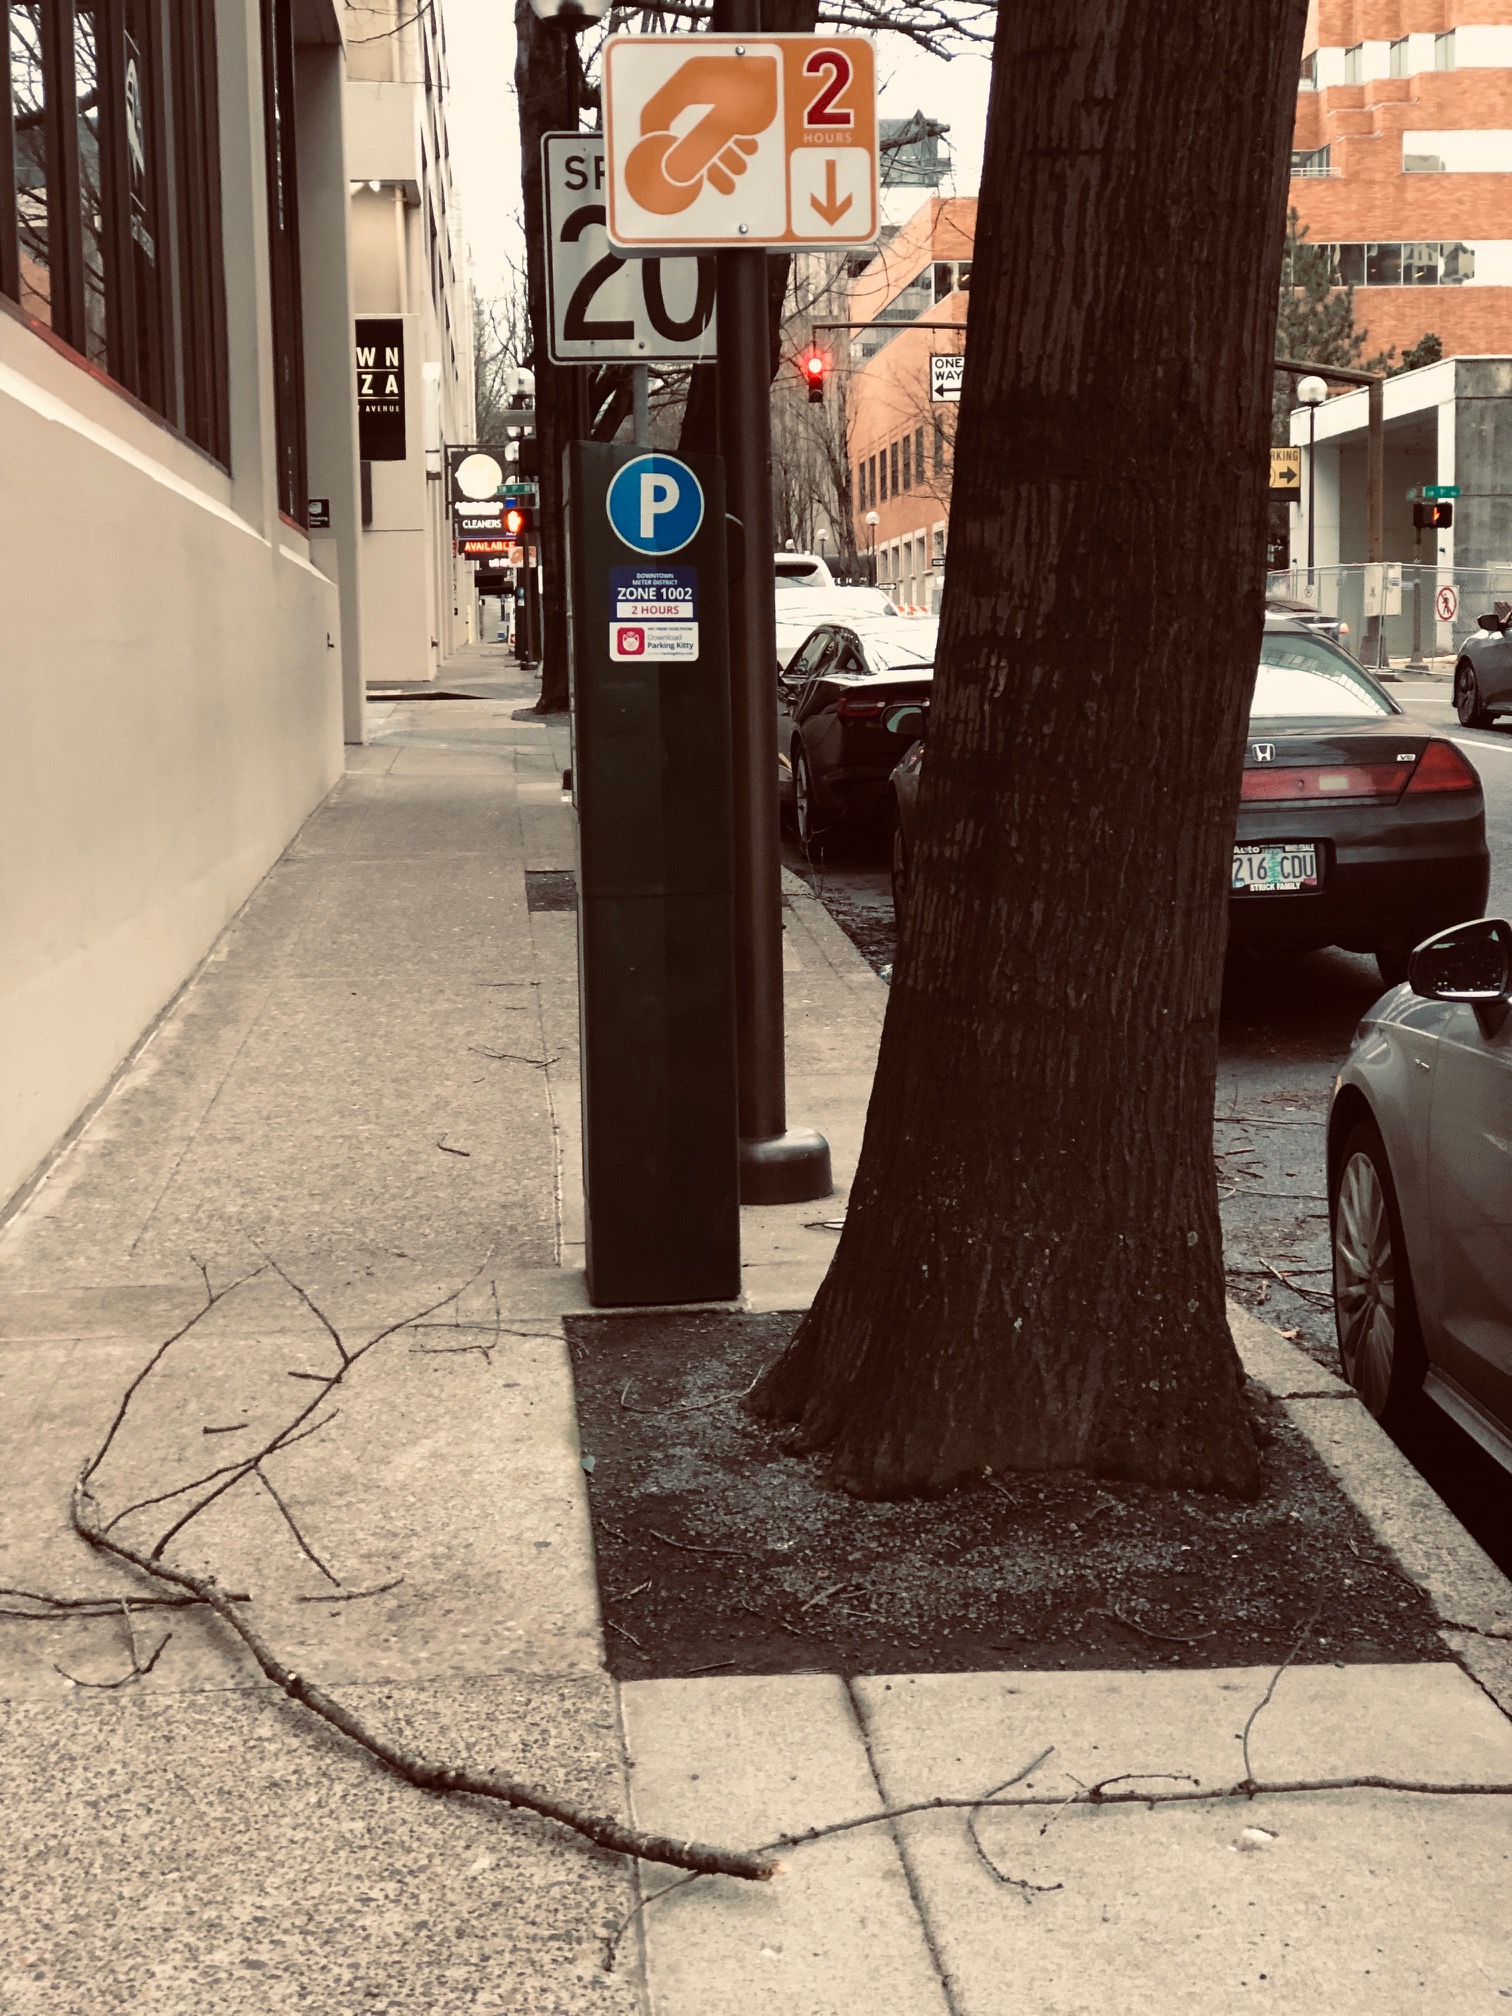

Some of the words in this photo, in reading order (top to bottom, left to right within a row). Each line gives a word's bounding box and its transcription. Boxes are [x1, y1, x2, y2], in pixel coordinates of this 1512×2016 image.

[803, 47, 854, 129] 2
[804, 132, 852, 144] HOURS
[559, 204, 717, 342] 20
[934, 358, 963, 369] ONE
[934, 371, 963, 381] WAY
[640, 473, 680, 538] P
[462, 519, 501, 528] CLEANERS
[464, 541, 516, 551] AVAILABLE
[617, 587, 657, 600] ZONE
[660, 587, 693, 600] 1002
[631, 605, 638, 615] 2
[641, 605, 679, 615] HOURS
[647, 642, 675, 650] Parking
[676, 642, 694, 650] Kitty
[1233, 857, 1268, 881] 216
[1280, 855, 1314, 879] CDU
[1276, 882, 1301, 890] FAMILY
